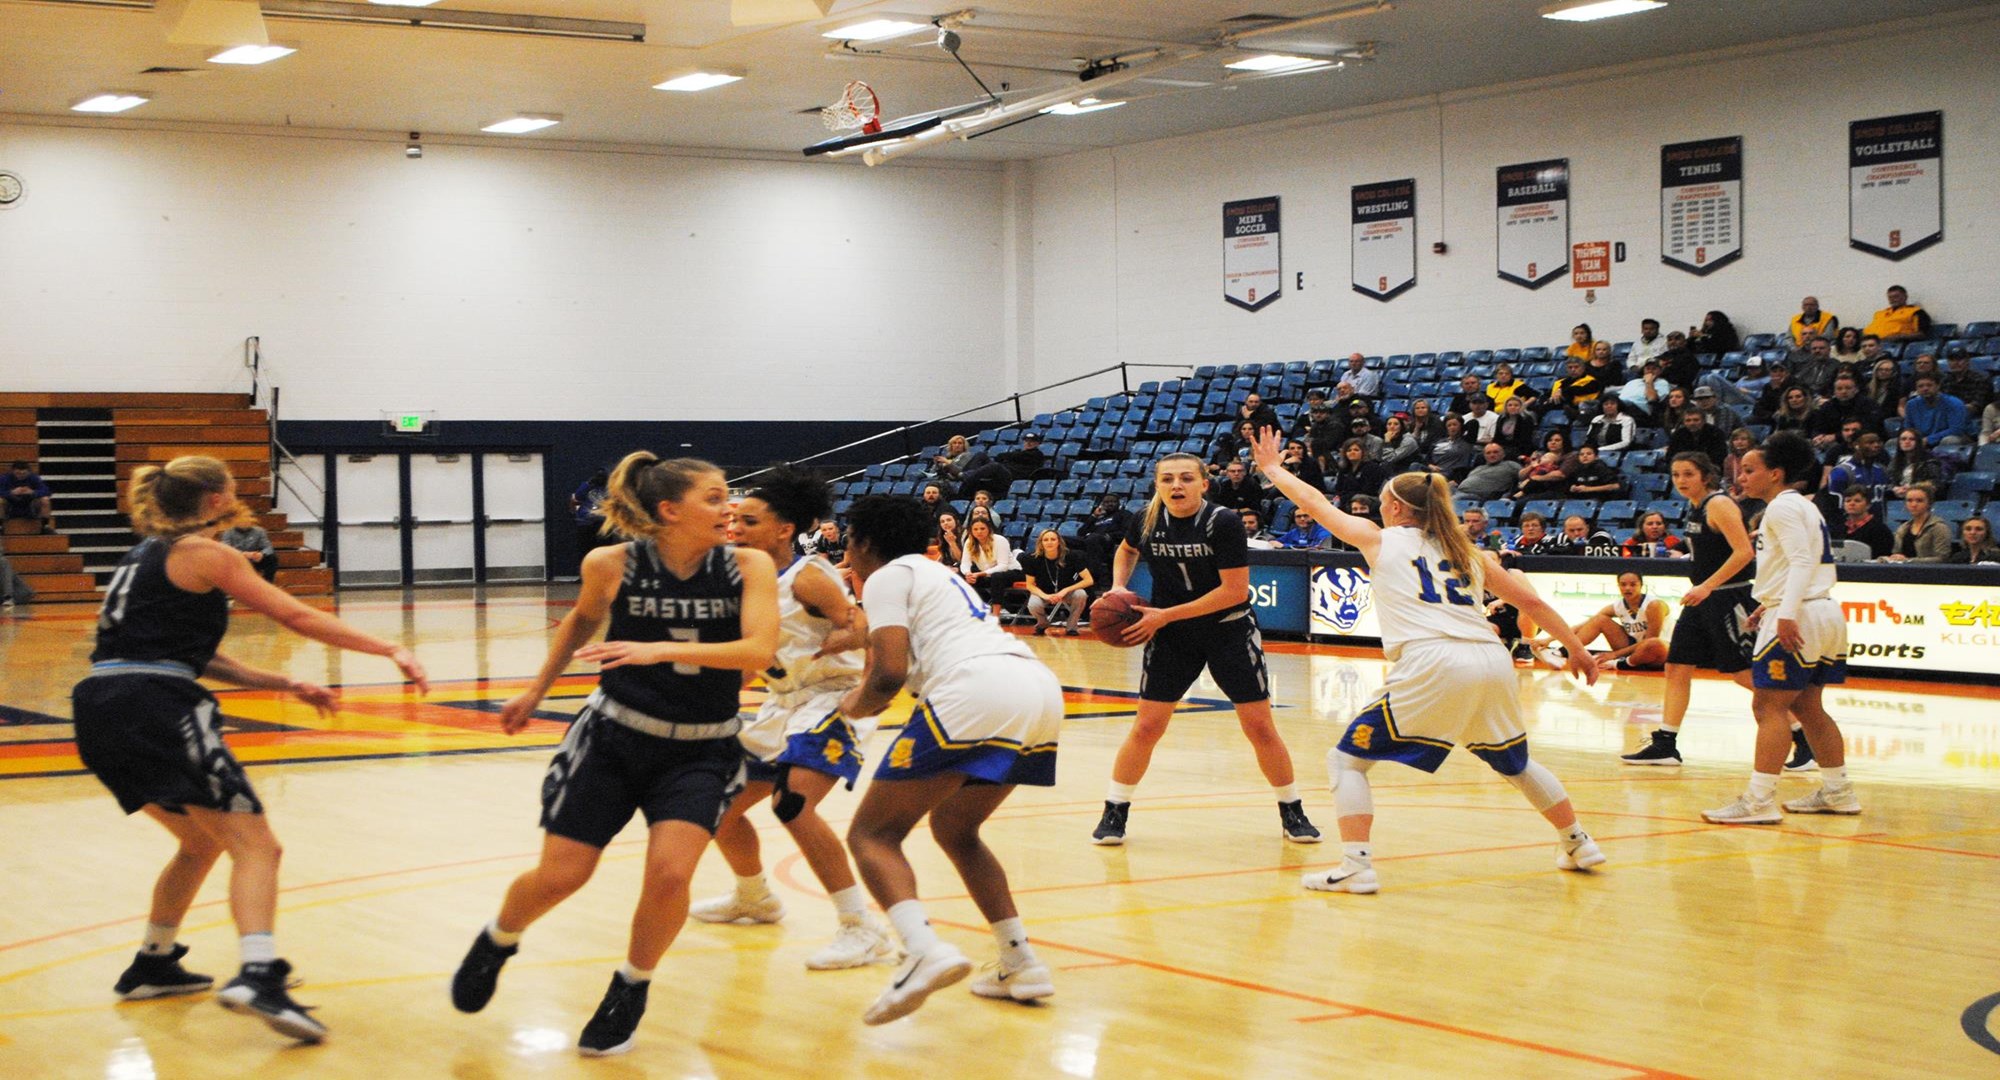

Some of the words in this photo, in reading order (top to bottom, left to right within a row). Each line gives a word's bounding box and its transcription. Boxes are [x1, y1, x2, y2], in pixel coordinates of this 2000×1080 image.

[1855, 138, 1935, 156] VOLLEYBALL
[1680, 163, 1723, 176] TENNIS
[1507, 182, 1557, 197] BASEBALL
[1357, 200, 1409, 215] WRESTLING
[1238, 214, 1264, 225] MEN'S
[1235, 223, 1267, 235] SOCCER
[1889, 230, 1901, 248] S
[1615, 242, 1626, 263] D
[1695, 247, 1706, 264] S
[1528, 263, 1537, 278] S
[1581, 259, 1601, 271] TEAM
[1296, 271, 1304, 290] E
[1379, 276, 1387, 291] S
[1151, 542, 1214, 558] EASTERN
[1584, 545, 1619, 557] POSS
[1177, 562, 1193, 591] 1
[1412, 555, 1474, 606] 12
[949, 577, 992, 621] 1
[627, 596, 739, 619] EASTERN
[1939, 600, 2000, 629] EA
[1903, 615, 1925, 626] AM
[1848, 643, 1926, 659] ports
